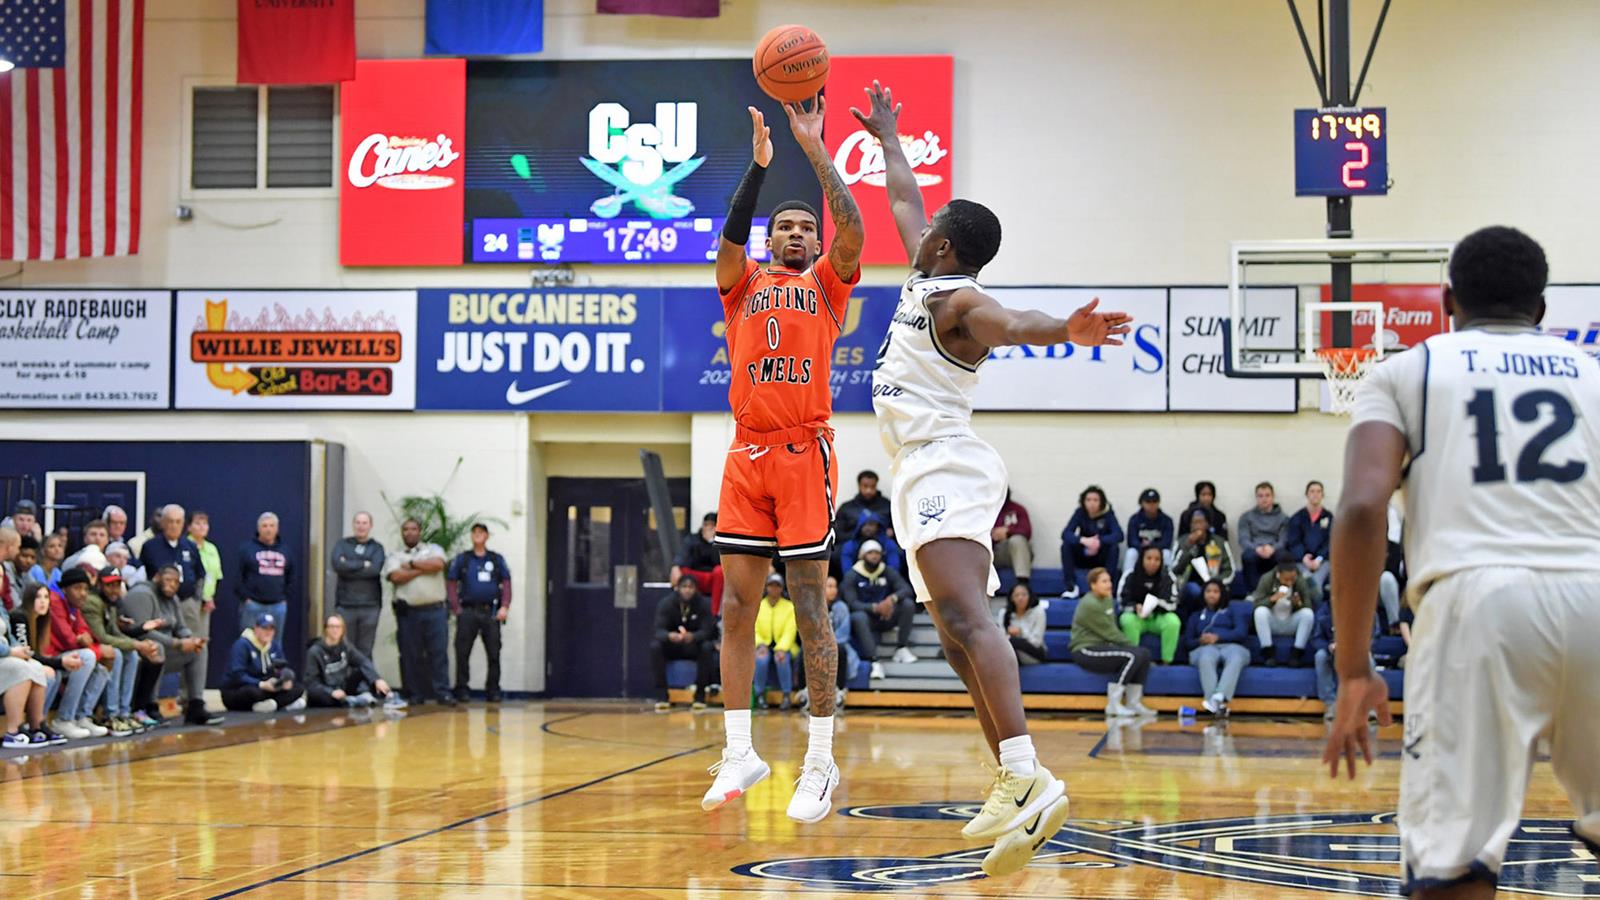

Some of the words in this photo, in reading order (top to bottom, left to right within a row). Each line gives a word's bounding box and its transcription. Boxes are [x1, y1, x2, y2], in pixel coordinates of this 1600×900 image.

[1311, 113, 1382, 139] 17:49
[589, 102, 697, 187] CSU
[833, 130, 947, 186] Cae's
[348, 133, 459, 188] Cane's
[1342, 142, 1369, 188] 2
[484, 233, 508, 252] 24
[603, 227, 678, 253] 17:49
[44, 298, 147, 319] RADEBAUGH
[448, 293, 638, 325] BUCCANEERS
[743, 285, 818, 318] IGHTING
[0, 318, 72, 341] asketball
[76, 315, 119, 344] Camp
[1386, 307, 1433, 326] Farm
[198, 339, 281, 356] WILLIE
[288, 339, 396, 356] JEWELL'S
[767, 316, 781, 350] 0
[436, 331, 528, 373] JUST
[533, 331, 592, 373] DO
[595, 332, 646, 373] IT.
[1461, 350, 1487, 372] T.
[1496, 353, 1579, 379] JONES
[260, 366, 286, 382] Old
[300, 369, 388, 393] Bar-B-Q
[0, 392, 58, 400] nformation
[1466, 389, 1587, 484] 12
